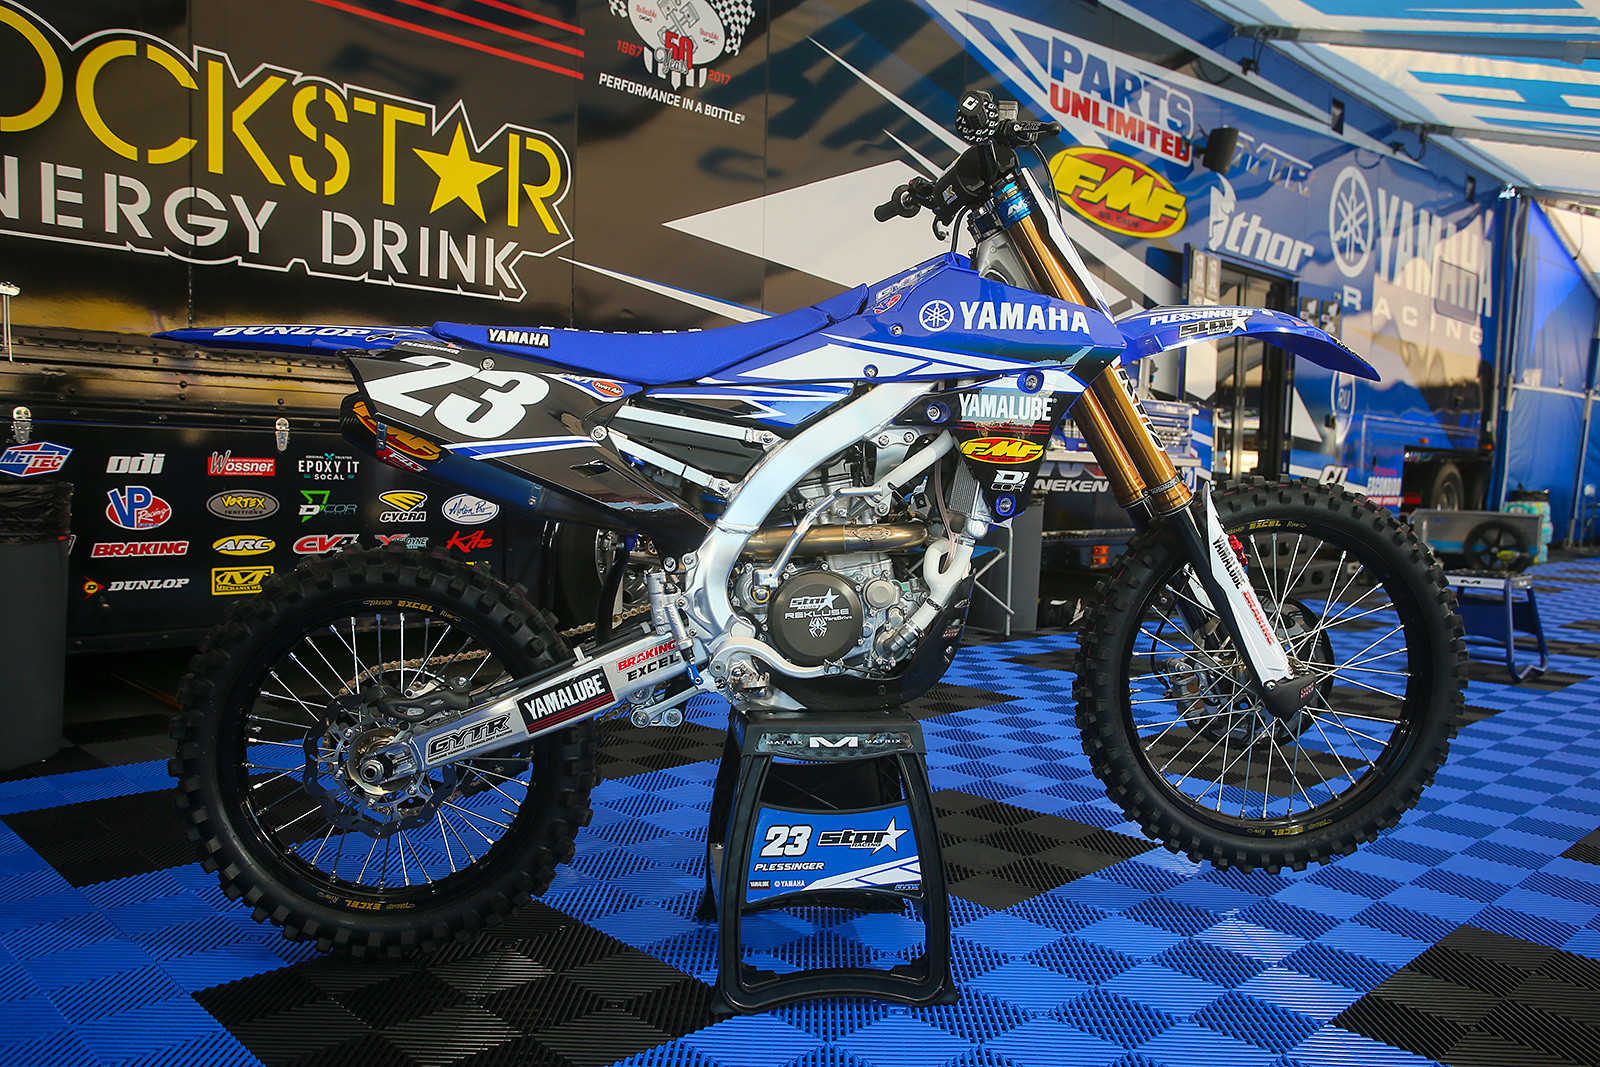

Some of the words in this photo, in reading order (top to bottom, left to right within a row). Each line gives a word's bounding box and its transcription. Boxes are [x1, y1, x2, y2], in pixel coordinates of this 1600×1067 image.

[616, 39, 644, 57] 1967
[664, 30, 694, 70] 50
[707, 68, 732, 85] 2017
[1050, 35, 1193, 136] PARTS
[598, 72, 682, 108] PERFORMANCE
[681, 97, 694, 112] IN
[694, 101, 703, 114] A
[1049, 82, 1192, 163] UNLIMITED
[1052, 153, 1187, 225] FMF
[321, 209, 518, 289] DRINK
[1224, 212, 1315, 272] thor
[1376, 187, 1494, 319] YAMAHA
[958, 301, 1091, 335] YAMAHA
[1149, 308, 1254, 326] PLESSINGER
[1342, 284, 1484, 347] RACING
[213, 326, 372, 337] DUNLOP
[488, 328, 549, 347] YAMAHA
[364, 354, 550, 439] 23
[594, 381, 610, 392] Twin
[609, 386, 623, 395] Air
[957, 392, 1053, 422] YAMALUBE
[961, 440, 1044, 459] FMF
[298, 460, 341, 473] EPOXY
[347, 461, 360, 474] IT
[314, 473, 345, 481] SOCAL
[1034, 479, 1111, 493] NEKEN
[107, 485, 153, 529] VP
[221, 495, 266, 510] VORTEX
[379, 510, 427, 523] CYCRA
[92, 541, 190, 558] BRAKING
[215, 539, 273, 551] ARC
[1211, 534, 1247, 590] YAMALUBE
[107, 578, 190, 592] DUNLOP
[397, 600, 434, 613] EXCEL
[784, 608, 850, 620] REKLUSE
[1242, 589, 1275, 646] BRAKING
[616, 638, 677, 672] BRAKING
[626, 653, 680, 682] EXCEL
[523, 674, 606, 721] YAMALUBE
[428, 714, 511, 758] GYTR
[760, 824, 813, 858] 23
[753, 861, 826, 872] PLESSINGER
[780, 879, 806, 888] YAMAHA
[344, 899, 383, 911] EXCEL
